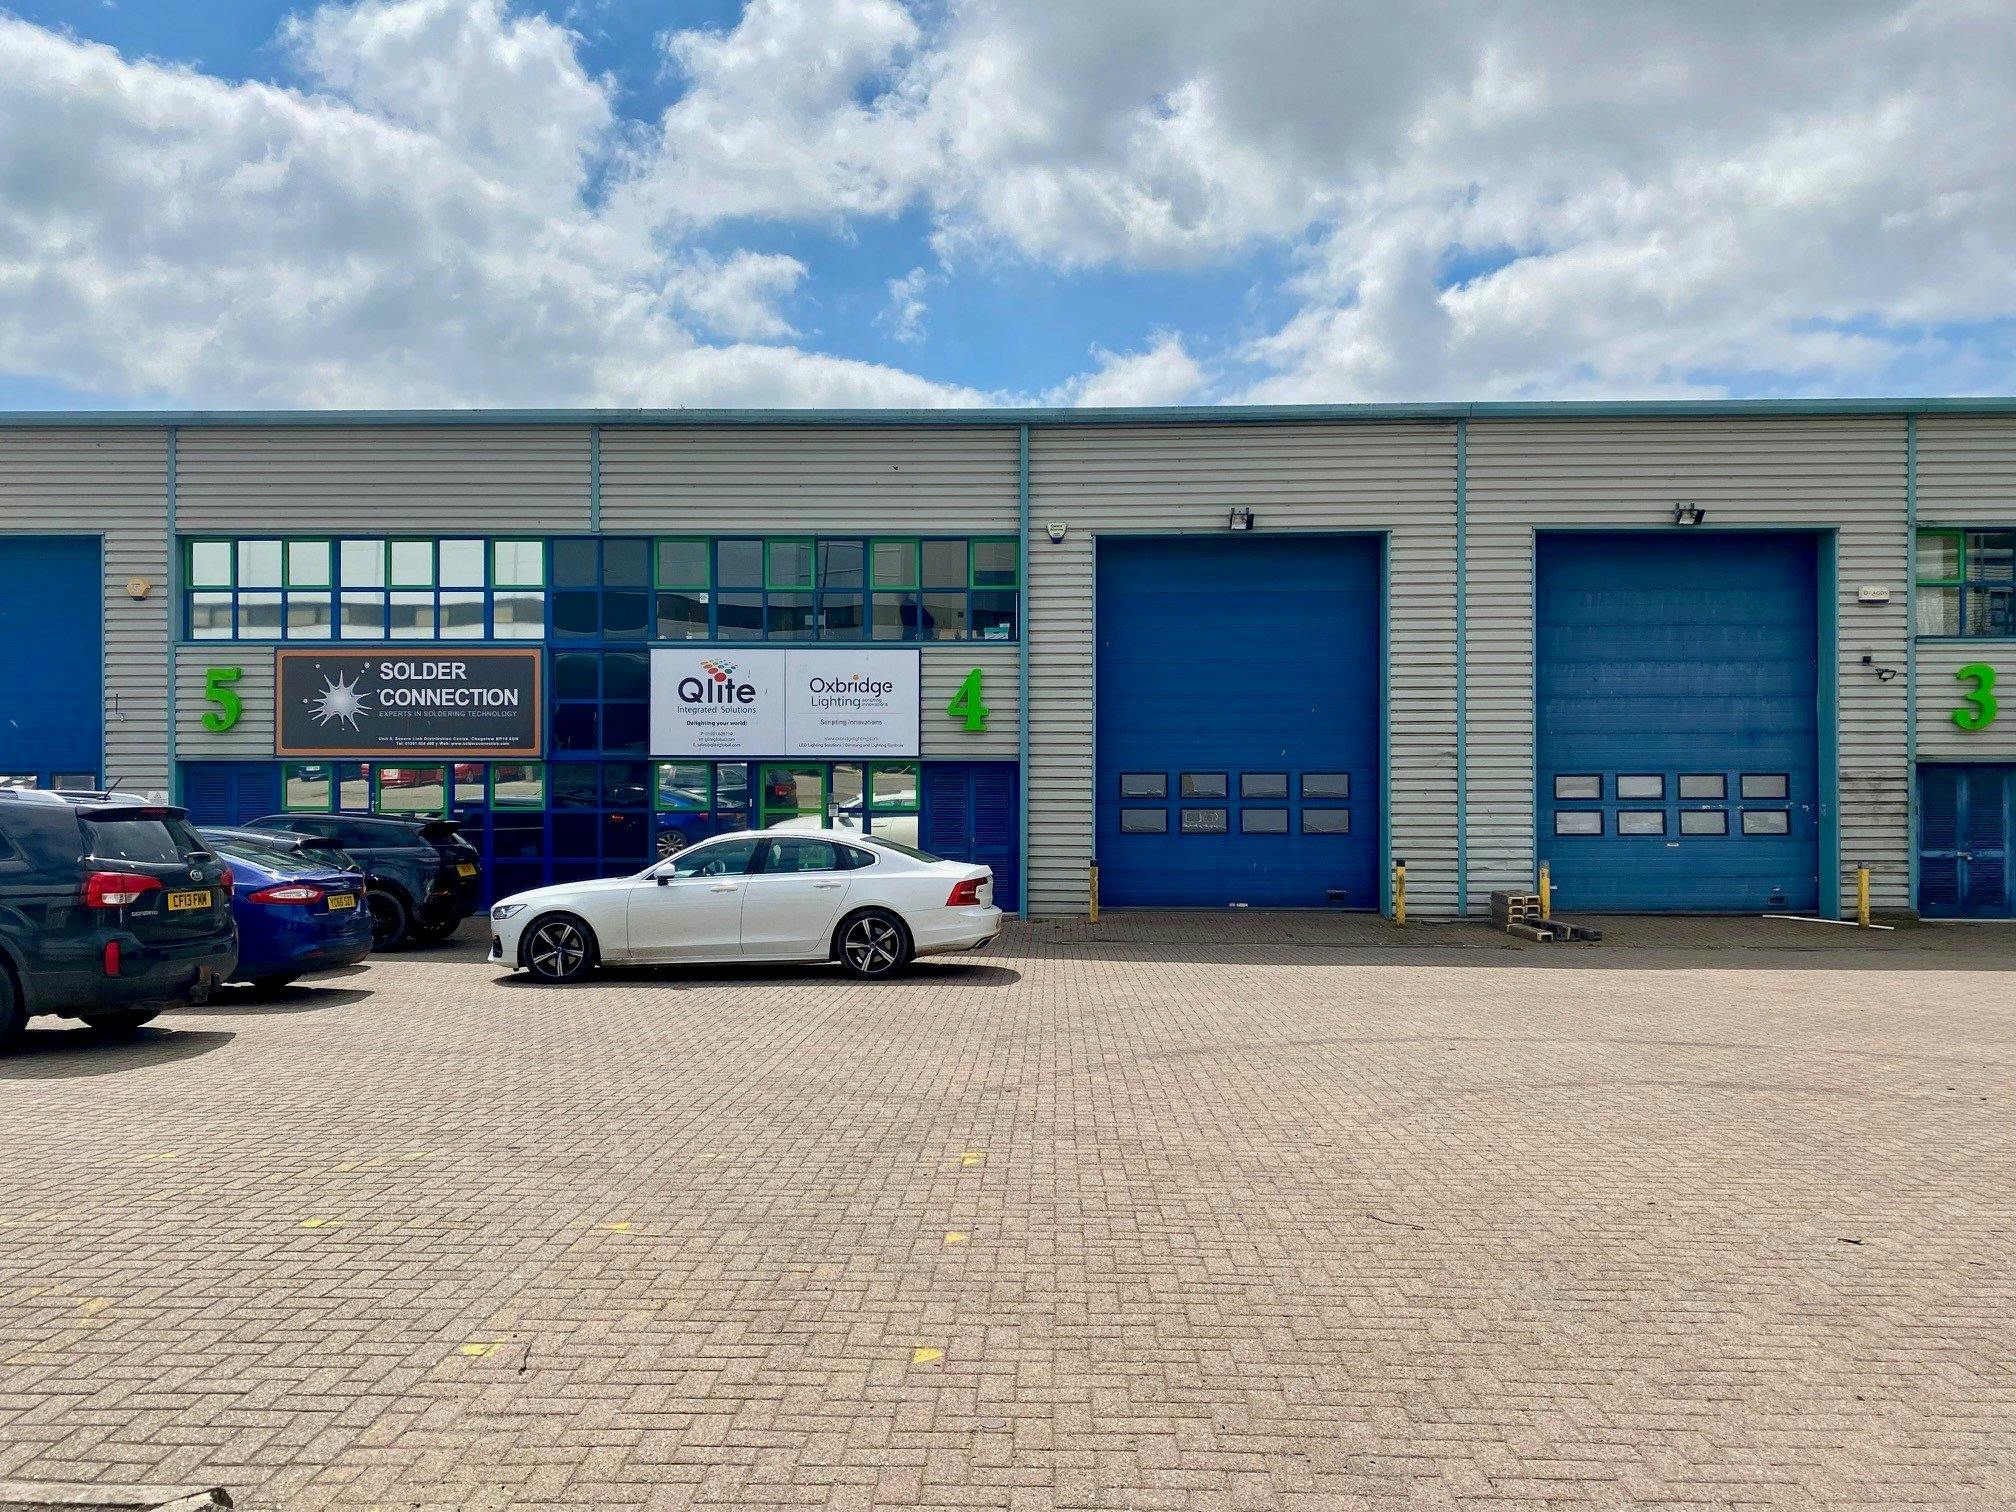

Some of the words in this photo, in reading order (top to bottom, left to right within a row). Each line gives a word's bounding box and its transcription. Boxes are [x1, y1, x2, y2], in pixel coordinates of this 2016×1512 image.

[380, 662, 467, 680] SOLDER
[678, 673, 756, 703] Qlite
[810, 675, 892, 697] Oxbridge
[1952, 662, 1997, 731] 3
[202, 667, 242, 731] 5
[380, 689, 518, 706] CONNECTION
[811, 696, 860, 709] Lighting
[946, 667, 989, 731] 4
[677, 706, 717, 715] Integrated
